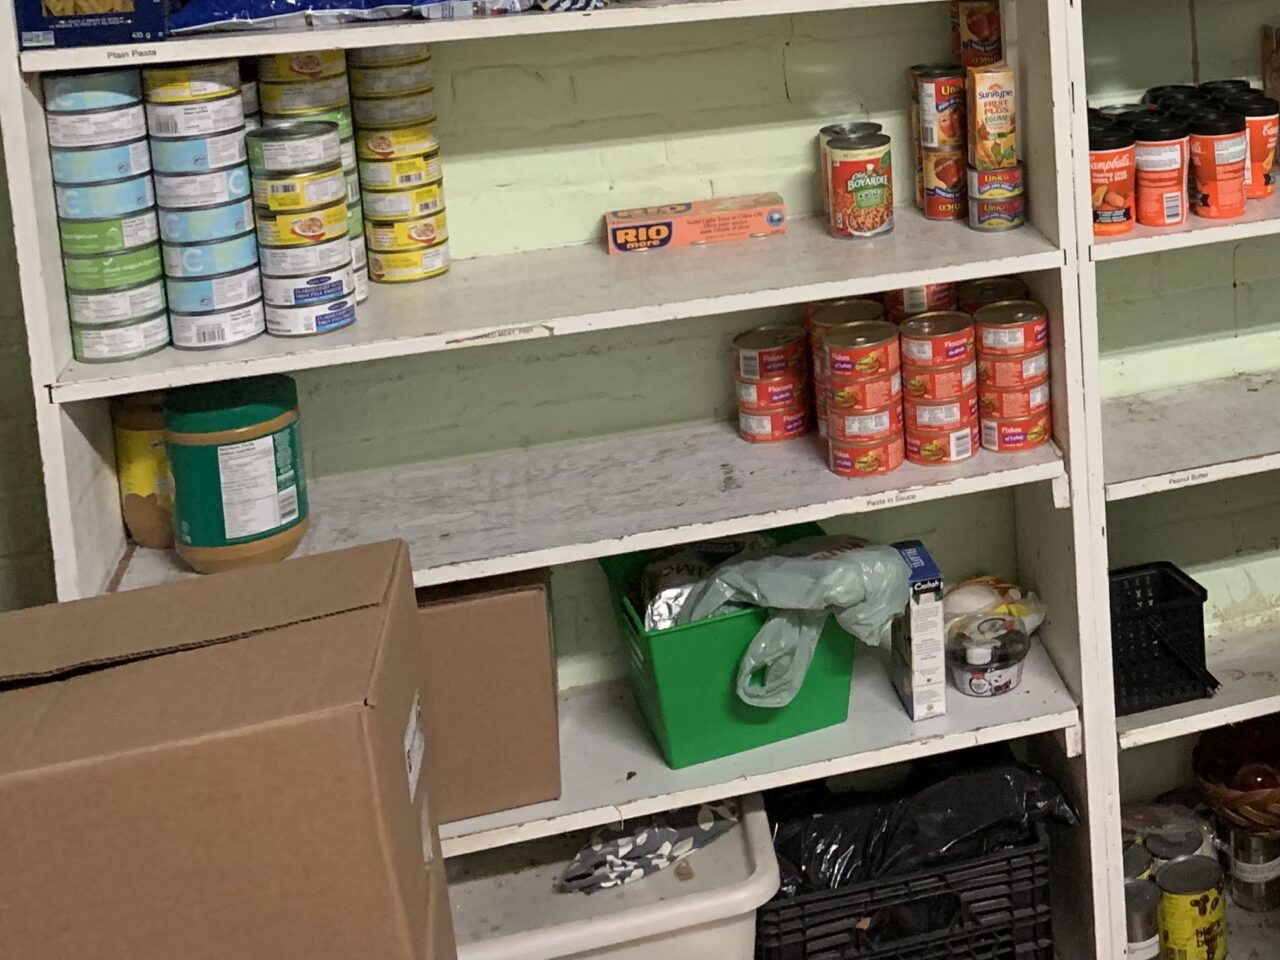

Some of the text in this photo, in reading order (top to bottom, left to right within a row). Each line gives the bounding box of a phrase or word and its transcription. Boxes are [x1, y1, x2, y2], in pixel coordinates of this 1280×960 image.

[107, 48, 157, 60] Plain Pasta
[978, 89, 1013, 101] SunRype
[983, 99, 1009, 109] FRUIT
[1091, 154, 1129, 171] ampbell's
[984, 174, 1009, 183] Unico
[615, 224, 669, 244] RIO
[626, 239, 661, 249] mare
[1169, 475, 1189, 485] Peanut
[866, 498, 886, 506] Pasta
[895, 494, 916, 503] Sauce
